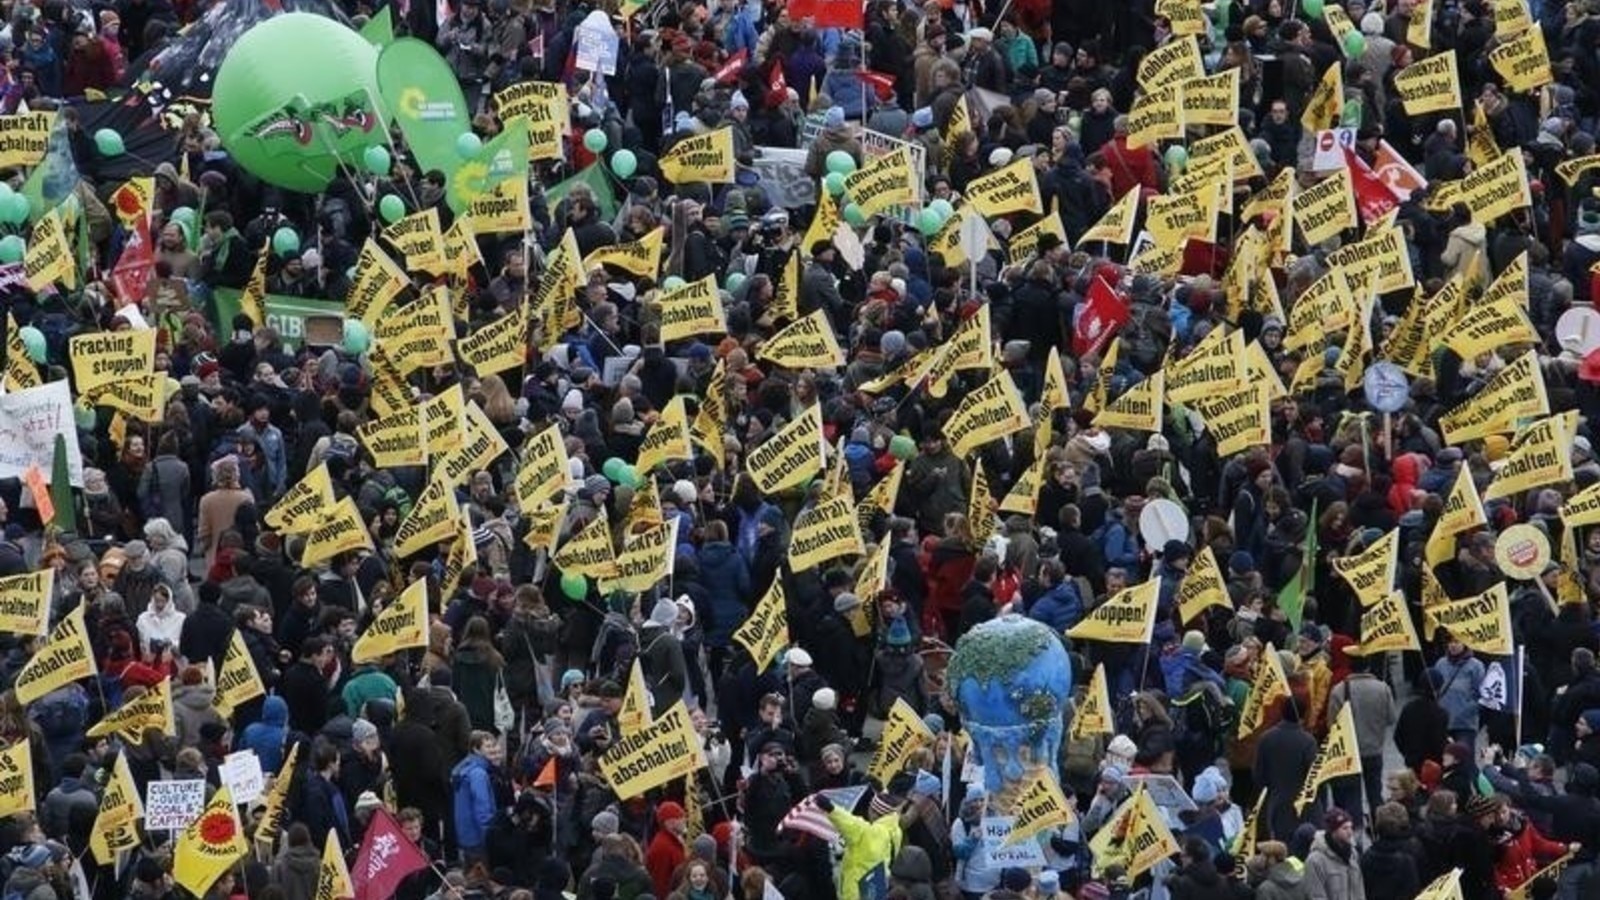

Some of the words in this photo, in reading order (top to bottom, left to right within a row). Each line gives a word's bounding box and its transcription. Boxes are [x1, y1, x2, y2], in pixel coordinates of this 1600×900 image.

[72, 337, 134, 360] Fracking
[93, 354, 148, 377] stoppen!
[612, 733, 691, 786] abschalten!
[150, 782, 200, 794] CULTURE
[160, 793, 190, 804] OVER
[155, 805, 184, 816] COAL
[186, 803, 195, 813] &
